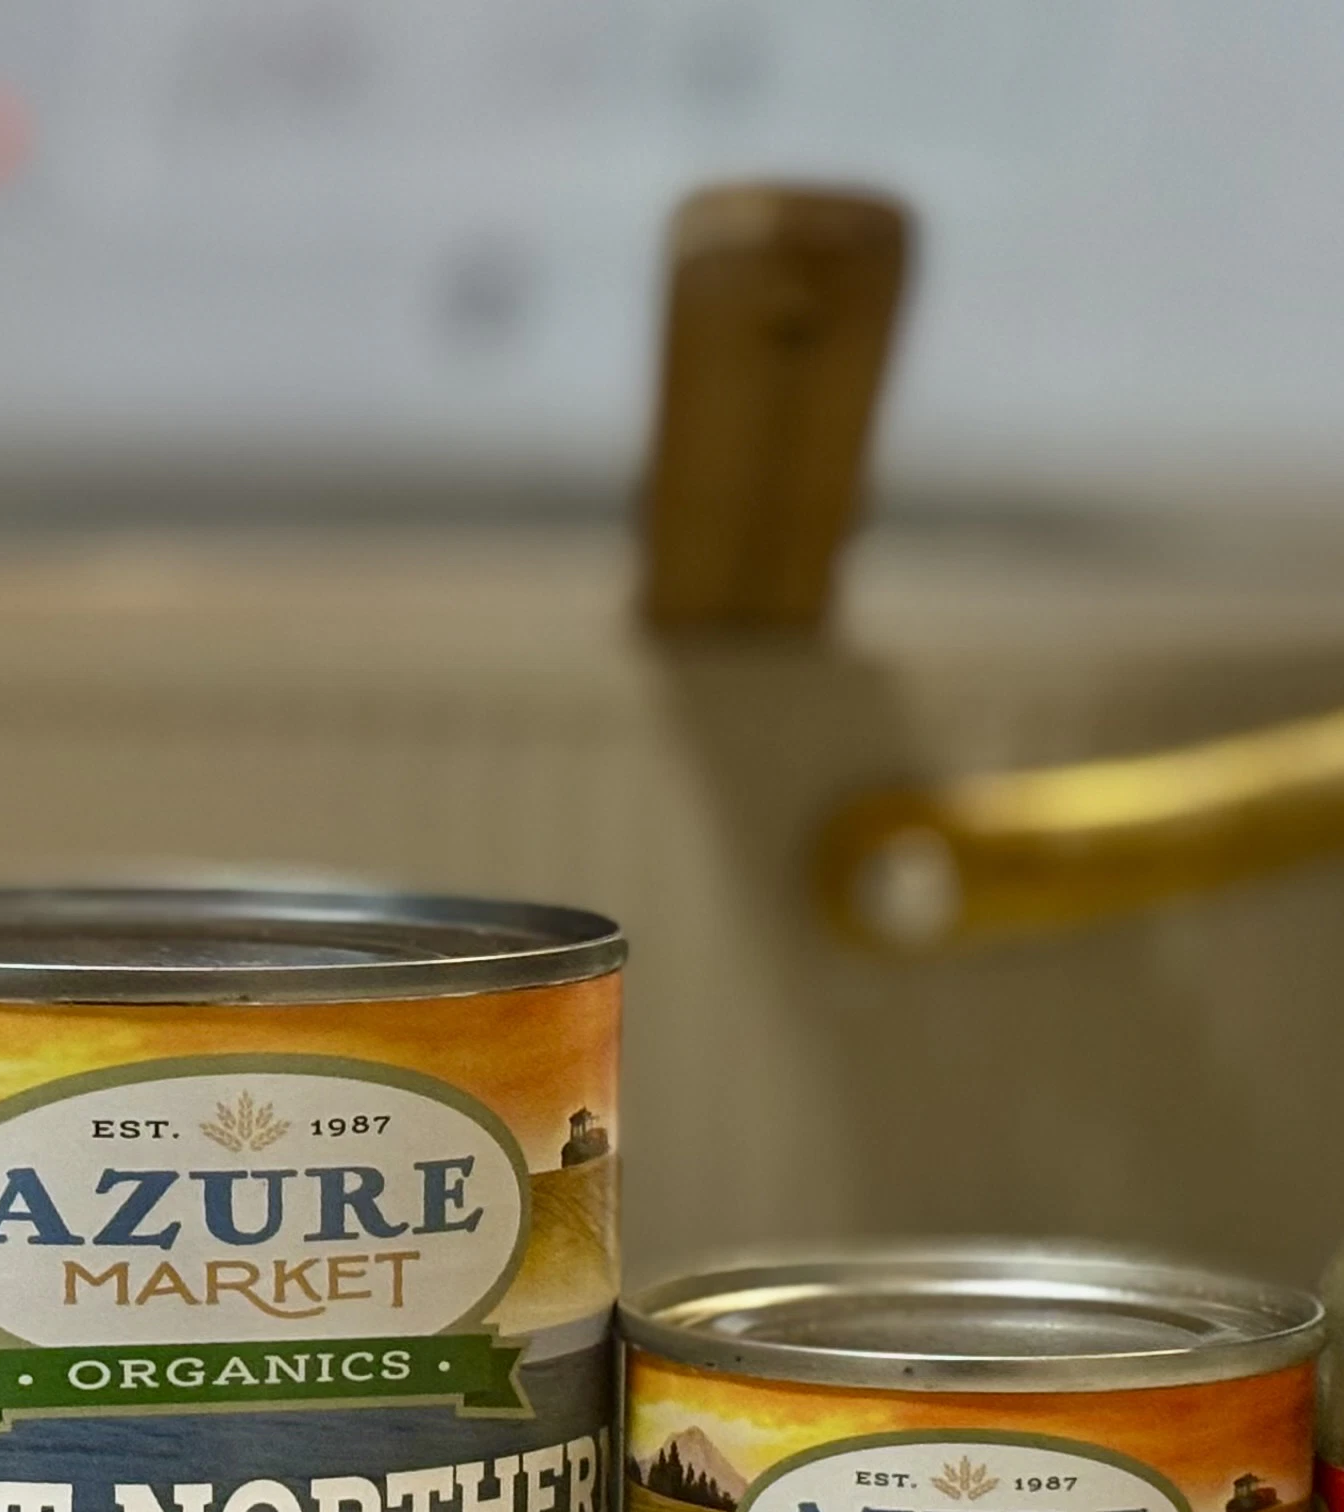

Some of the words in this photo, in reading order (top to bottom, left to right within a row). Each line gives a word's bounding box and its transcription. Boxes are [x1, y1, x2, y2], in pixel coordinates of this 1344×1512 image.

[91, 1118, 180, 1140] EST.
[310, 1115, 392, 1138] 1987
[62, 1250, 421, 1319] MARKET
[67, 1351, 412, 1390] ORGANICS
[855, 1470, 918, 1490] EST.
[1013, 1475, 1078, 1493] 1987
